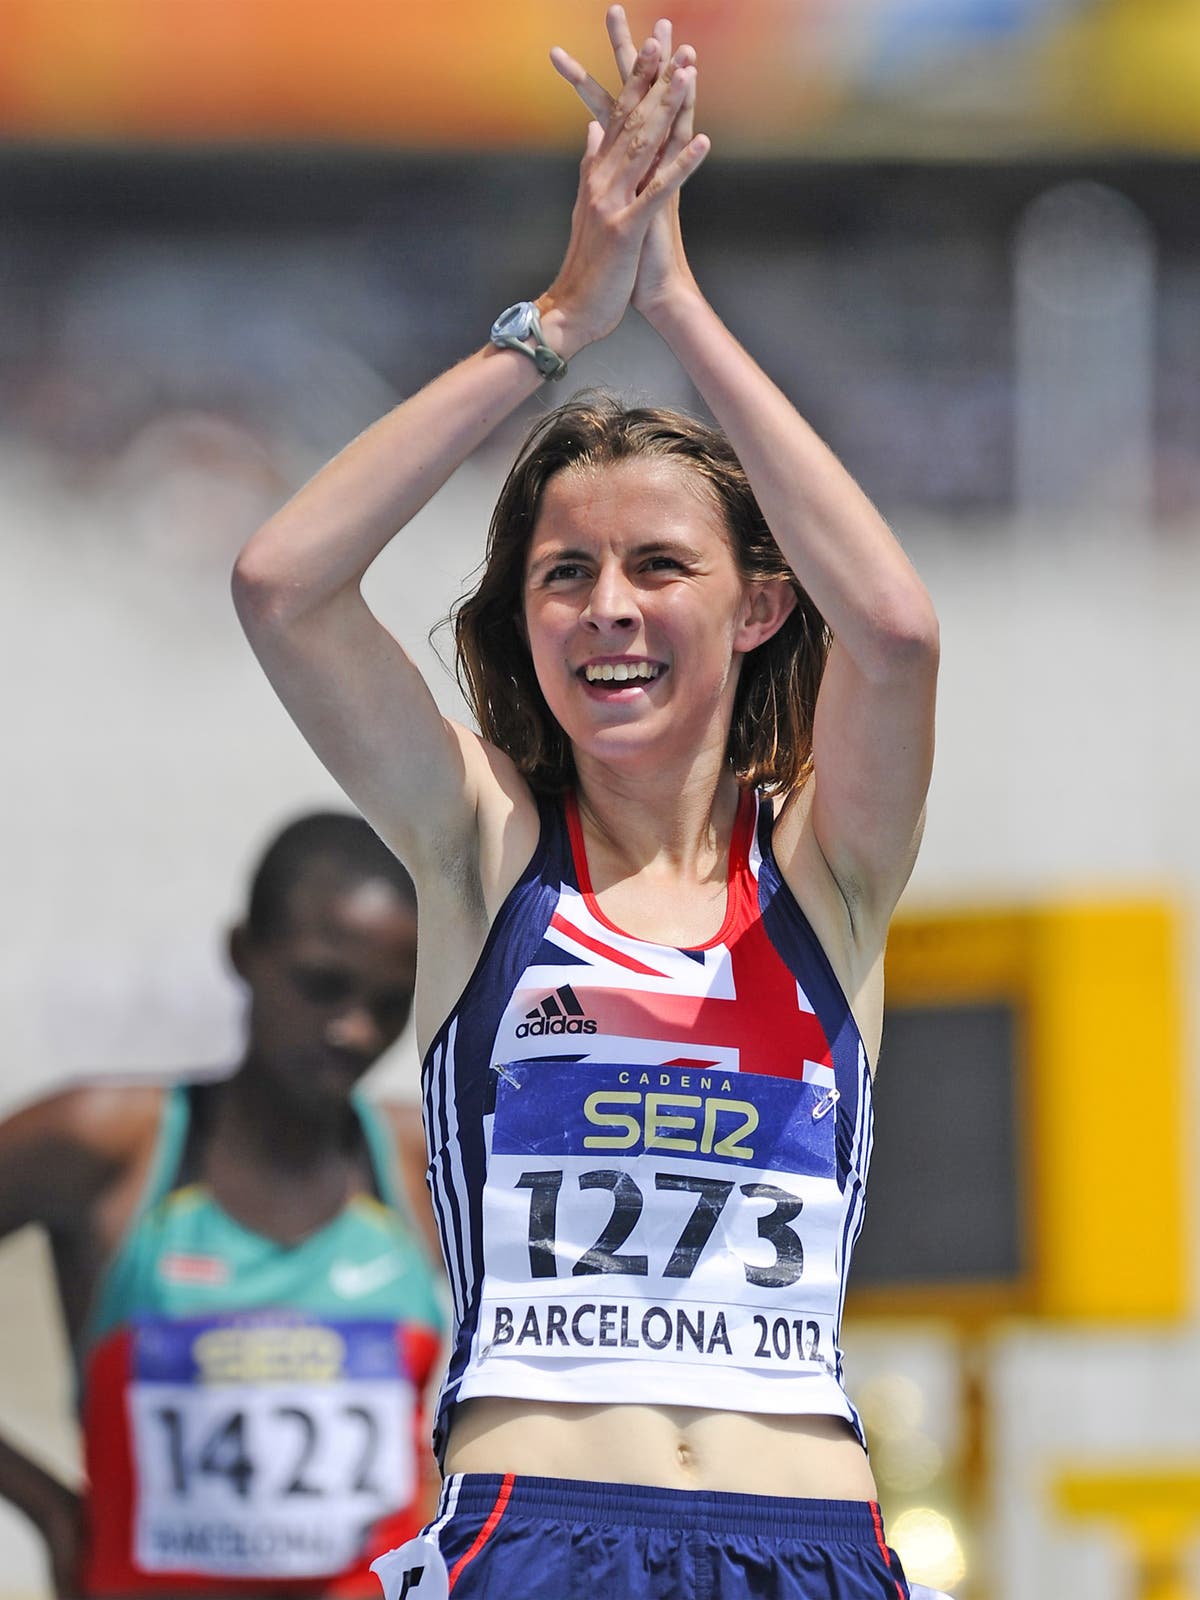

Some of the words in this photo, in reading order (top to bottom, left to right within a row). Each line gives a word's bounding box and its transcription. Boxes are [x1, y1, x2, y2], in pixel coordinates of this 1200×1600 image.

[515, 1016, 597, 1039] adidas
[619, 1071, 732, 1091] CADENA
[583, 1092, 759, 1160] SER
[514, 1170, 803, 1288] 1273
[494, 1304, 733, 1355] BARCELONA
[753, 1315, 825, 1362] 2012
[157, 1406, 386, 1499] 1422
